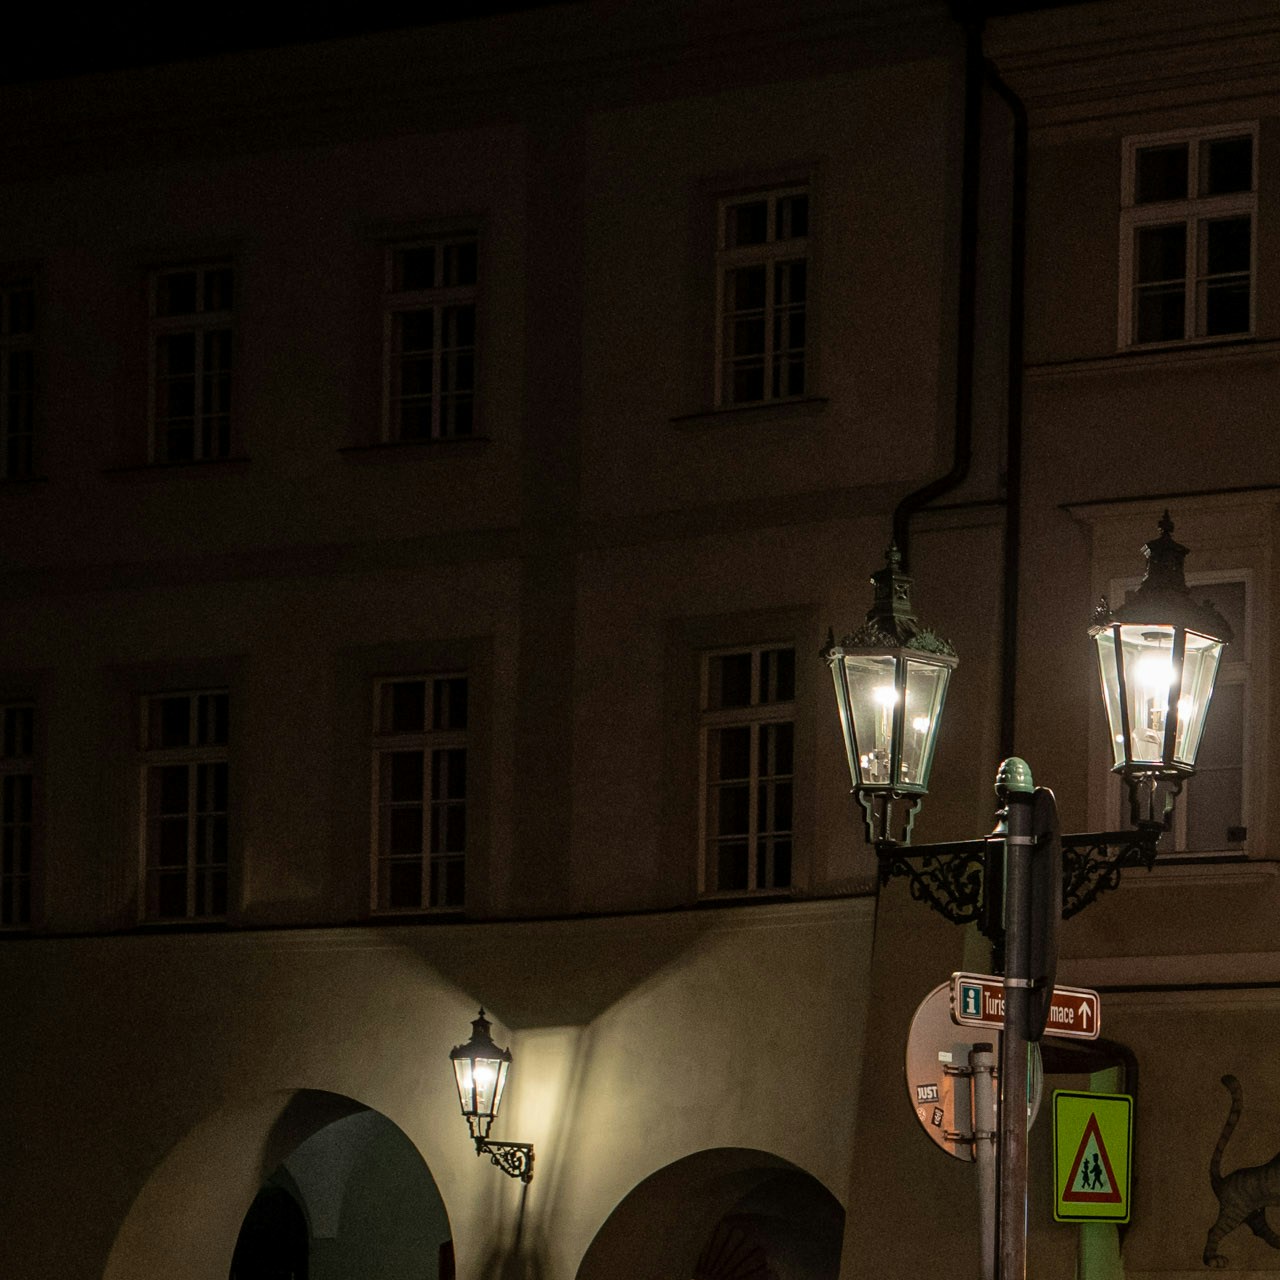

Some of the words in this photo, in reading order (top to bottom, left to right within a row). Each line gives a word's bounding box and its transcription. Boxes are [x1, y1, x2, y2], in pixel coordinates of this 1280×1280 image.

[984, 991, 1005, 1016] Turis
[1050, 1004, 1075, 1024] mace
[917, 1086, 938, 1100] JUST
